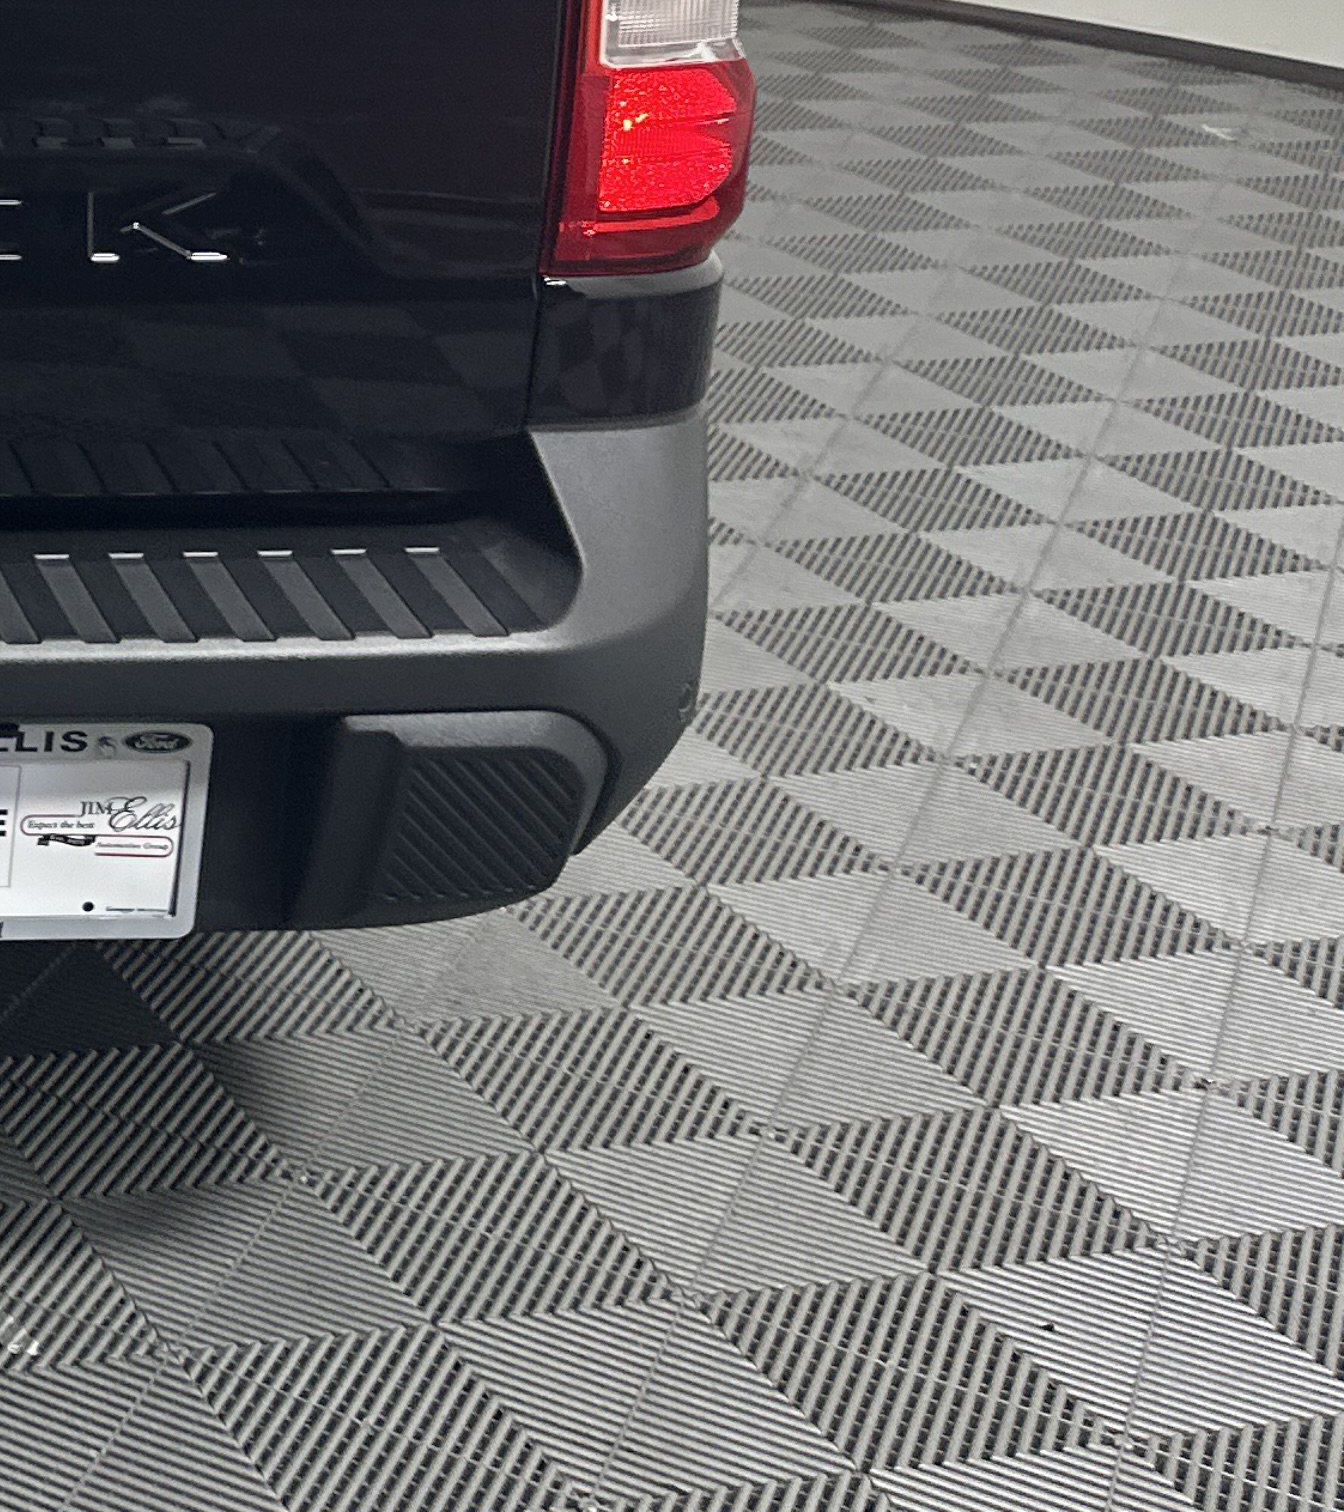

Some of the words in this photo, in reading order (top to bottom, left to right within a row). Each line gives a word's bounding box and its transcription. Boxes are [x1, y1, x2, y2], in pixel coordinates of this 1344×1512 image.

[133, 733, 188, 750] Ford
[79, 800, 114, 816] JIM
[107, 796, 181, 832] Ellis
